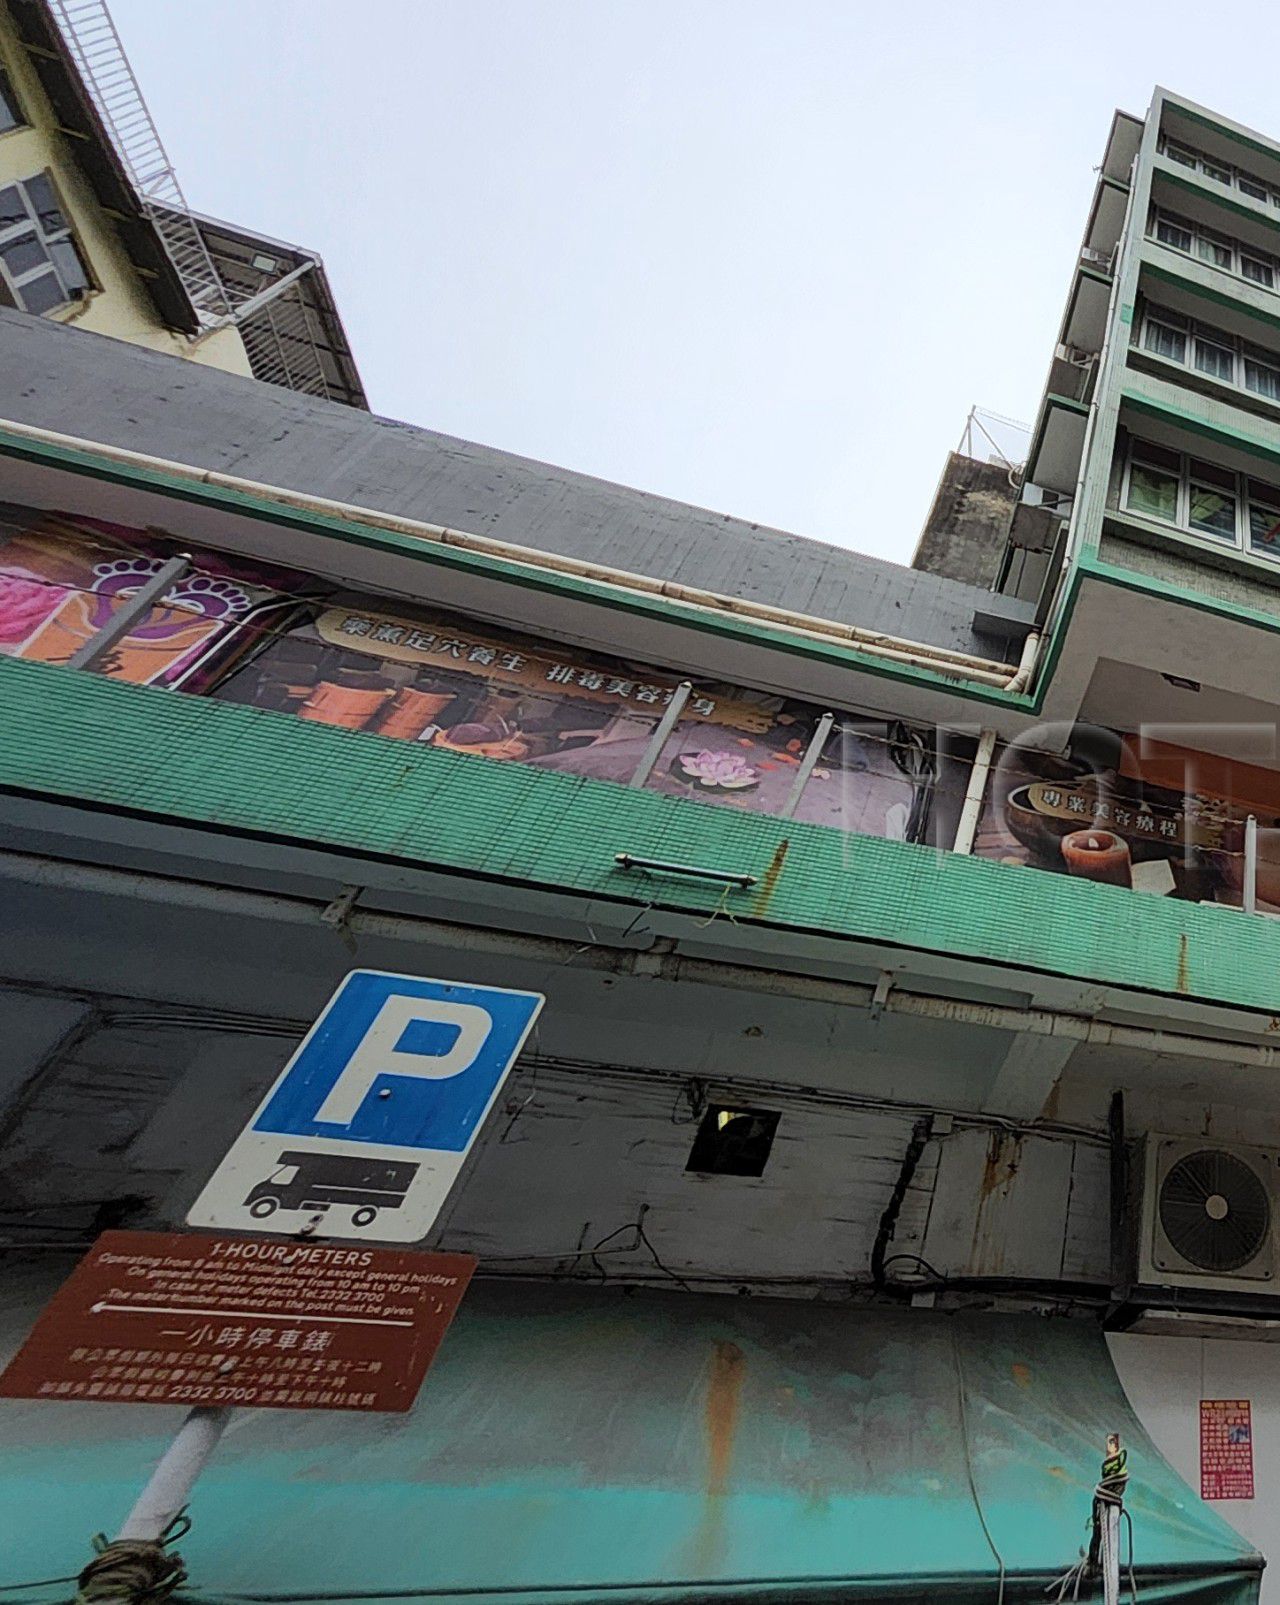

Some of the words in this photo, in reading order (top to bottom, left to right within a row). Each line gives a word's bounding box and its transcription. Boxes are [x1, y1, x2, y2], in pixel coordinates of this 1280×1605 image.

[546, 664, 716, 717] 排毒美容身
[313, 994, 493, 1126] P
[210, 1242, 288, 1261] 1-HOUR
[293, 1248, 374, 1267] METERS
[98, 1252, 162, 1267] Operating
[163, 1257, 191, 1267] from
[227, 1262, 239, 1271] to
[297, 1267, 324, 1279] daily
[326, 1269, 366, 1281] except
[367, 1271, 409, 1284] general
[411, 1274, 458, 1287] holidays
[128, 1266, 146, 1277] On
[307, 1278, 335, 1289] from
[338, 1279, 351, 1290] 10
[352, 1281, 370, 1290] am
[372, 1282, 385, 1291] to
[387, 1283, 401, 1293] 10
[401, 1285, 420, 1295] pm
[266, 1299, 283, 1308] on
[286, 1299, 305, 1310] the
[306, 1302, 334, 1313] post
[335, 1304, 364, 1313] must
[365, 1304, 379, 1314] be
[353, 1292, 385, 1302] 3700
[159, 1324, 333, 1351] 一小時停車錶
[168, 1385, 214, 1399] 2332
[213, 1387, 258, 1401] 3700
